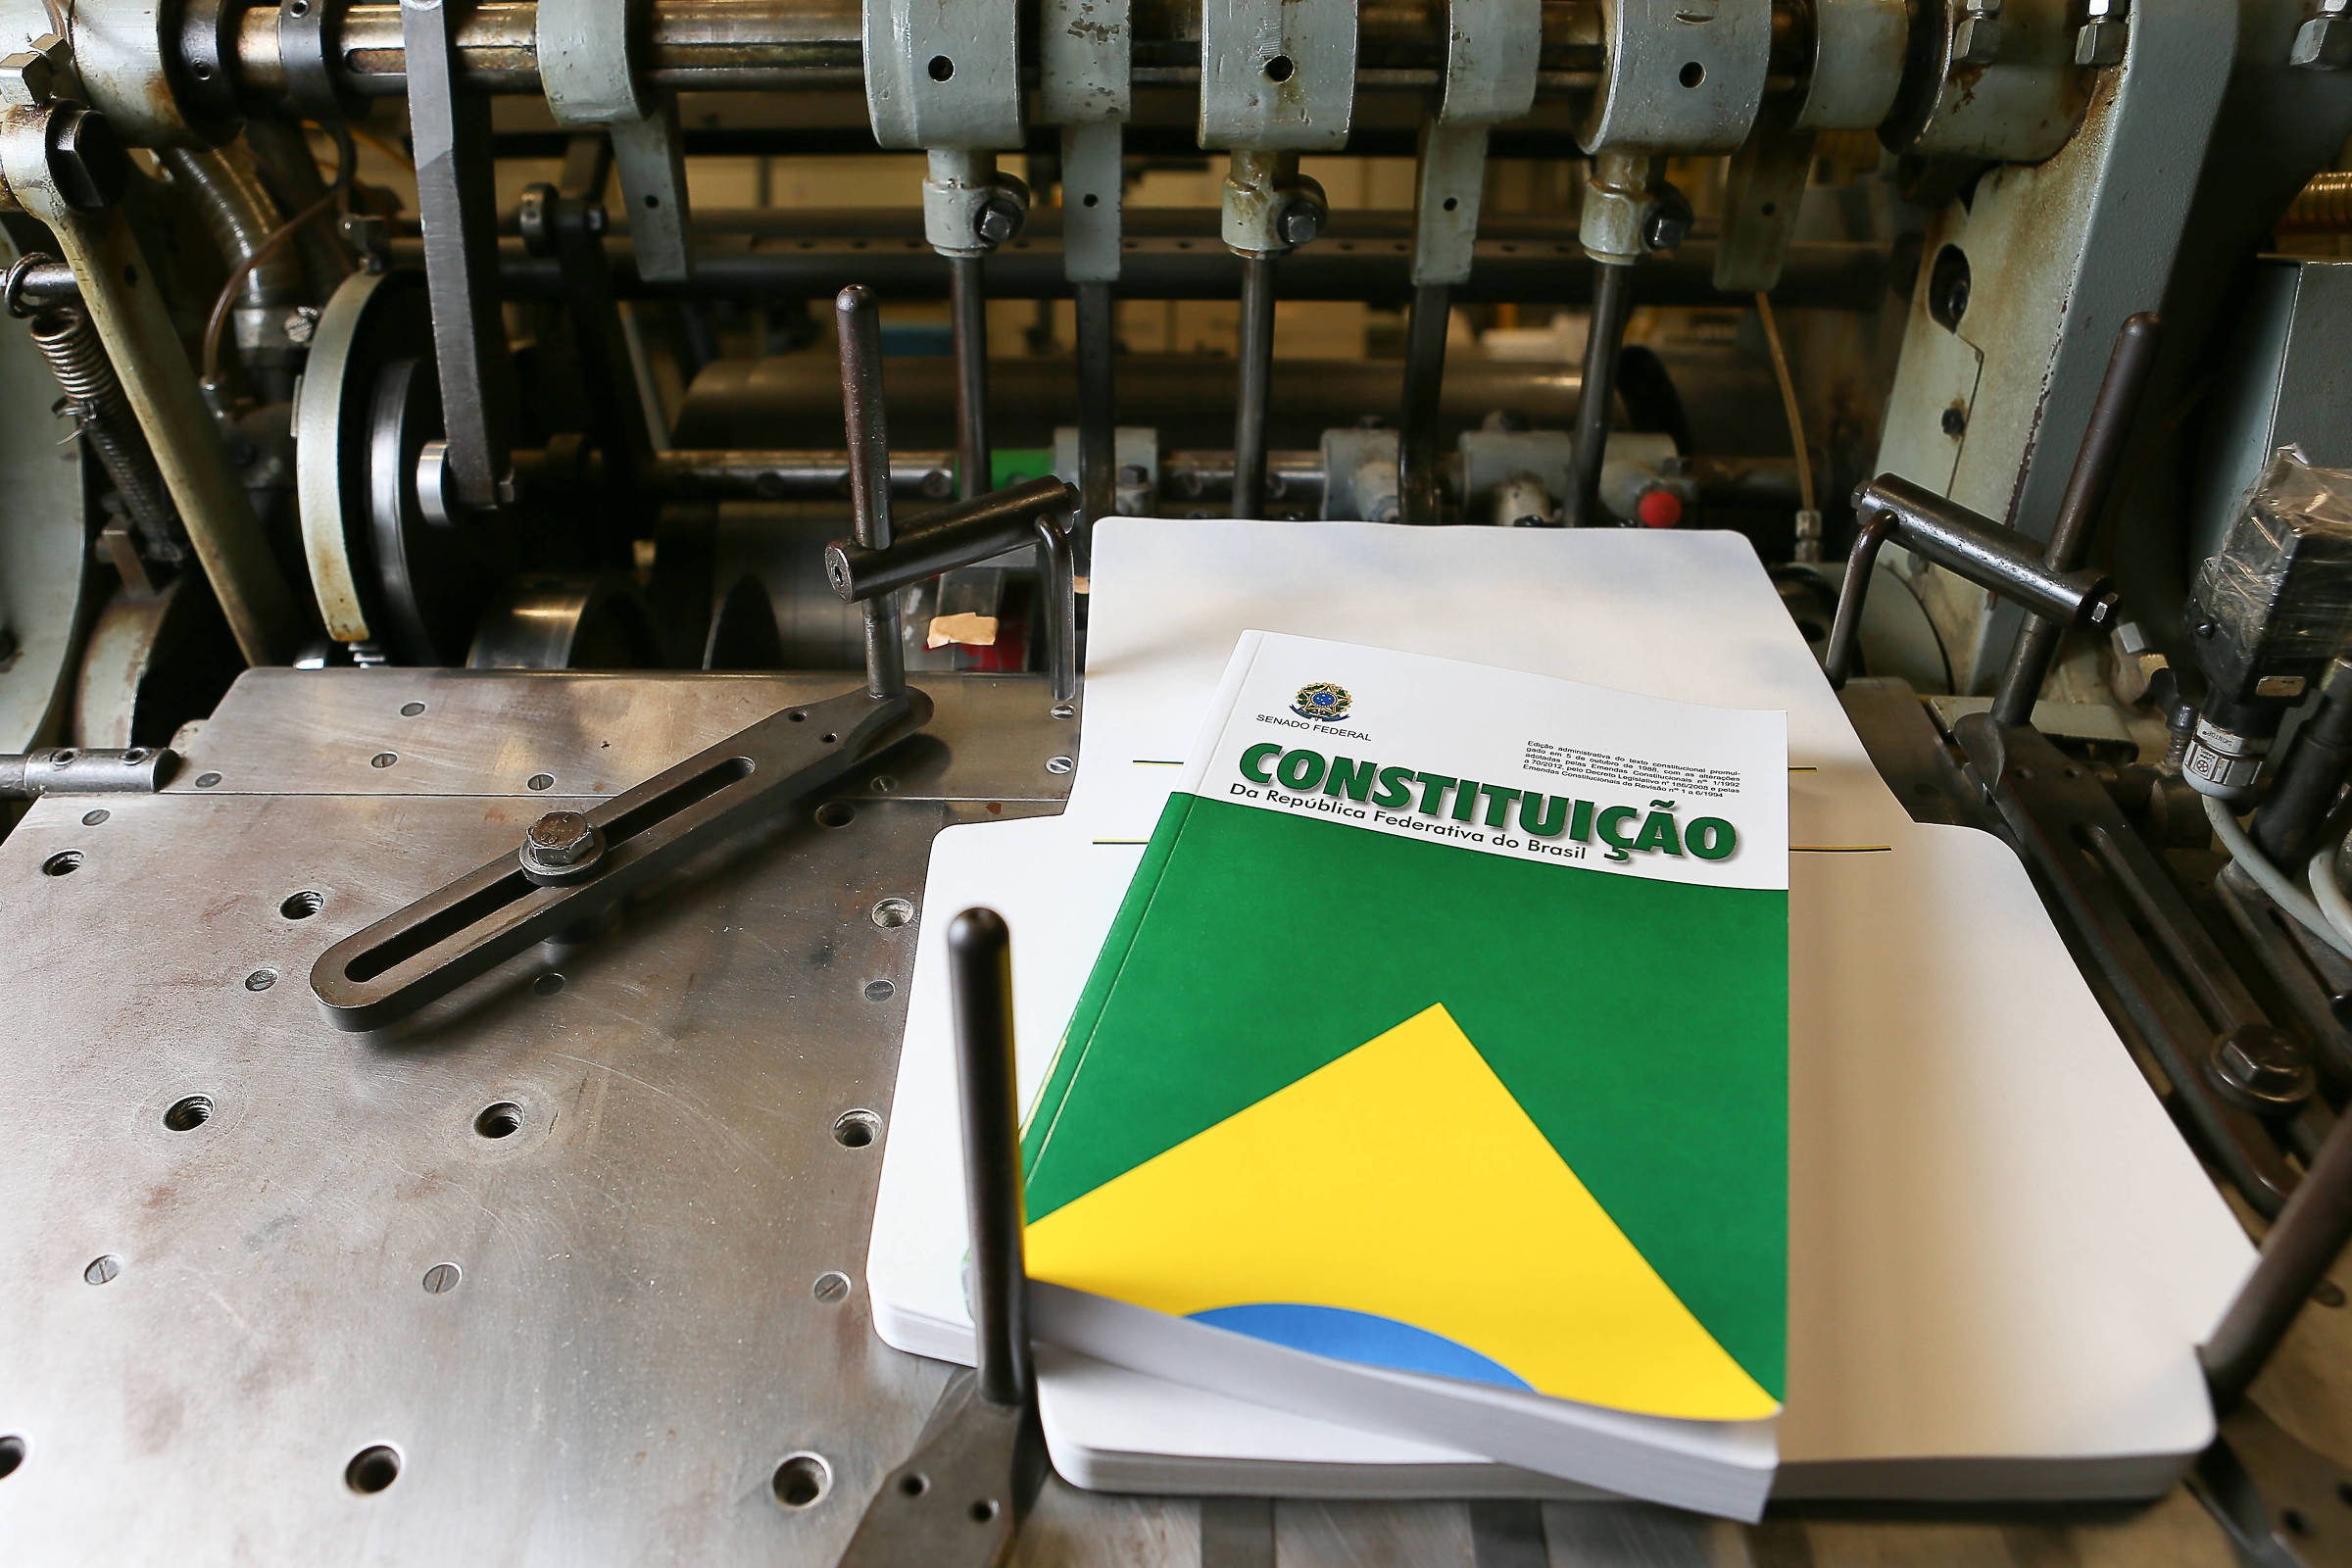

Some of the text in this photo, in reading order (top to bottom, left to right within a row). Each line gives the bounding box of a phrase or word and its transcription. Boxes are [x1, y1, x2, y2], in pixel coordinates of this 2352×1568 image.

[1256, 713, 1372, 741] SENADO FEDERAL
[1525, 753, 1560, 762] adotadas
[1592, 762, 1629, 774] Emendas
[1633, 770, 1692, 783] Constitucionais
[1527, 741, 1554, 750] Edição
[1558, 747, 1611, 760] administrativa
[1652, 762, 1705, 773] constitucional
[1590, 758, 1619, 766] outubro
[1699, 773, 1740, 782] alterações
[1523, 764, 1560, 774] Emendas
[1561, 770, 1621, 785] Constitucionais
[1635, 782, 1667, 792] Revisão
[1586, 768, 1617, 778] Decreto
[1618, 774, 1660, 785] Legislativo
[1239, 742, 1736, 861] CONSTITUIÇÃO
[1229, 783, 1587, 859] Da República Federativa do Brasil
